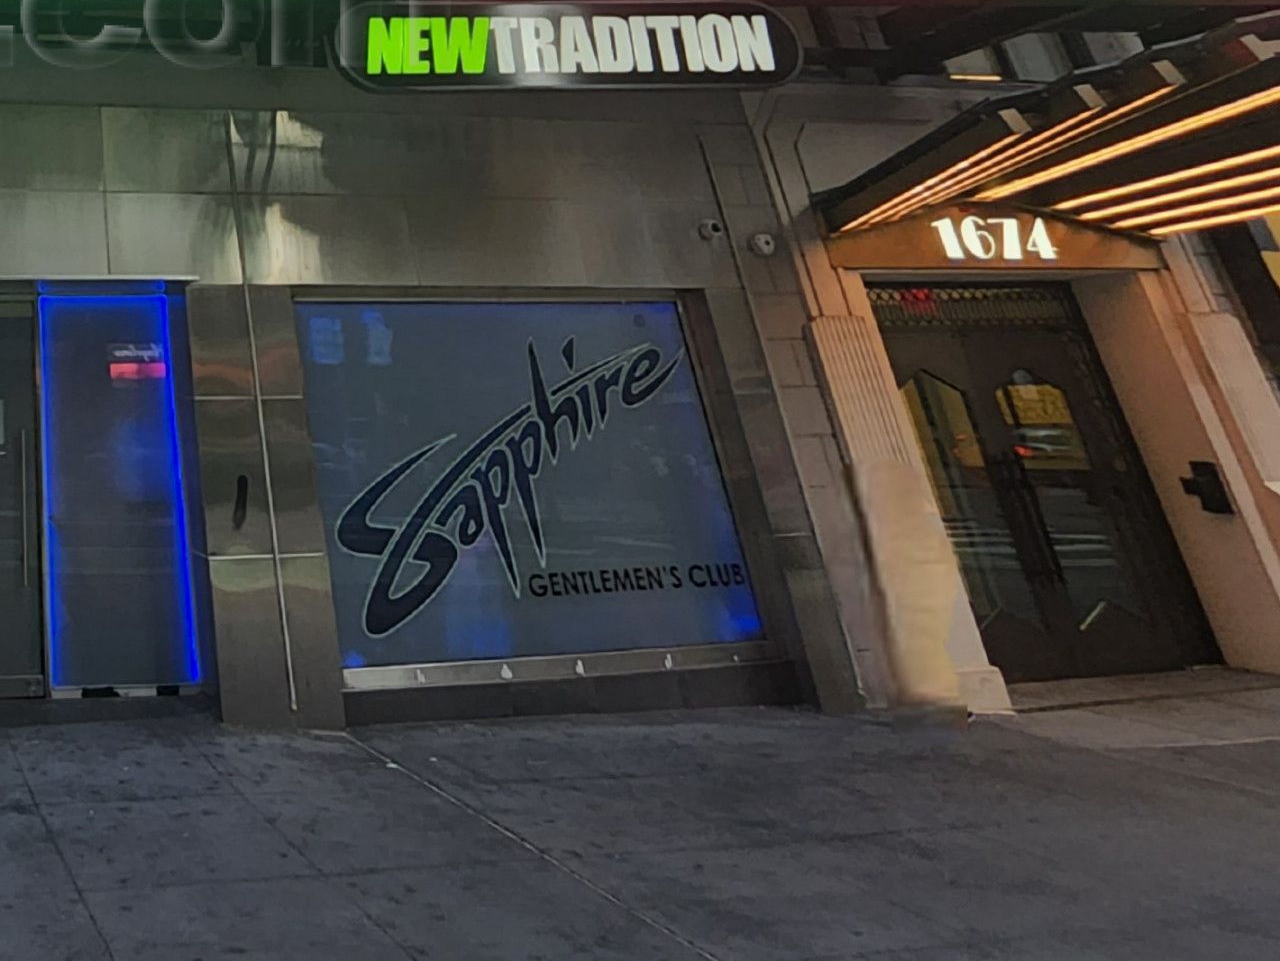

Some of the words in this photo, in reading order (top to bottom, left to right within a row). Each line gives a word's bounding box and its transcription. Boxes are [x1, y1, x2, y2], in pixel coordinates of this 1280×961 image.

[930, 215, 1059, 260] 1674
[336, 332, 685, 638] Sapphire
[528, 565, 683, 598] GENTLEMEN'S
[688, 563, 745, 587] CLUB
